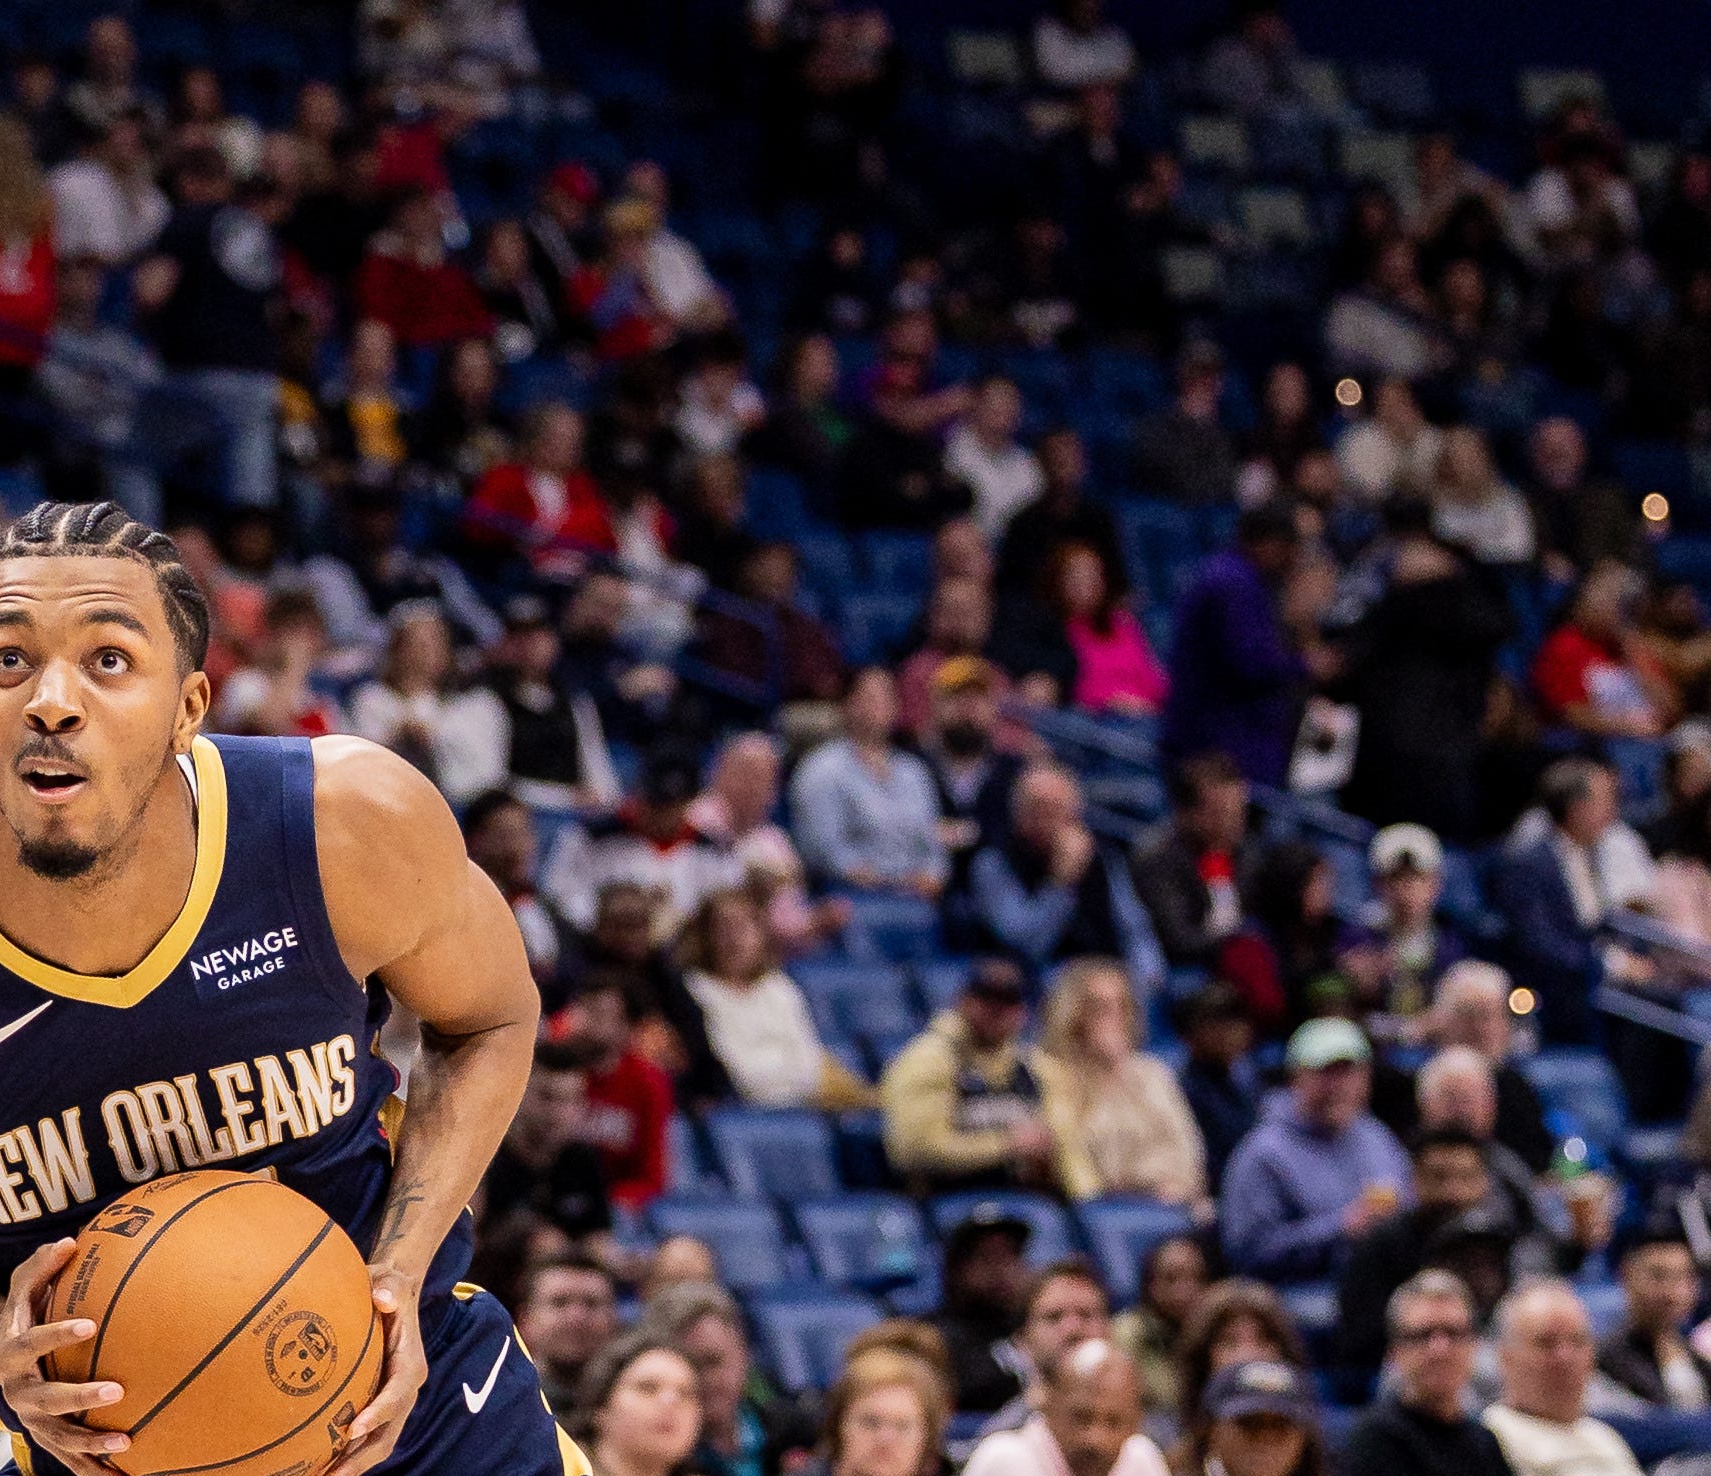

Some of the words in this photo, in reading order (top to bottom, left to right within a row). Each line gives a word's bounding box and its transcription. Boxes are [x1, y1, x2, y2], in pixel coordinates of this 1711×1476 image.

[190, 927, 298, 980] NEWAGE
[217, 956, 286, 989] GARAGE
[101, 1033, 357, 1184] ORLEANS
